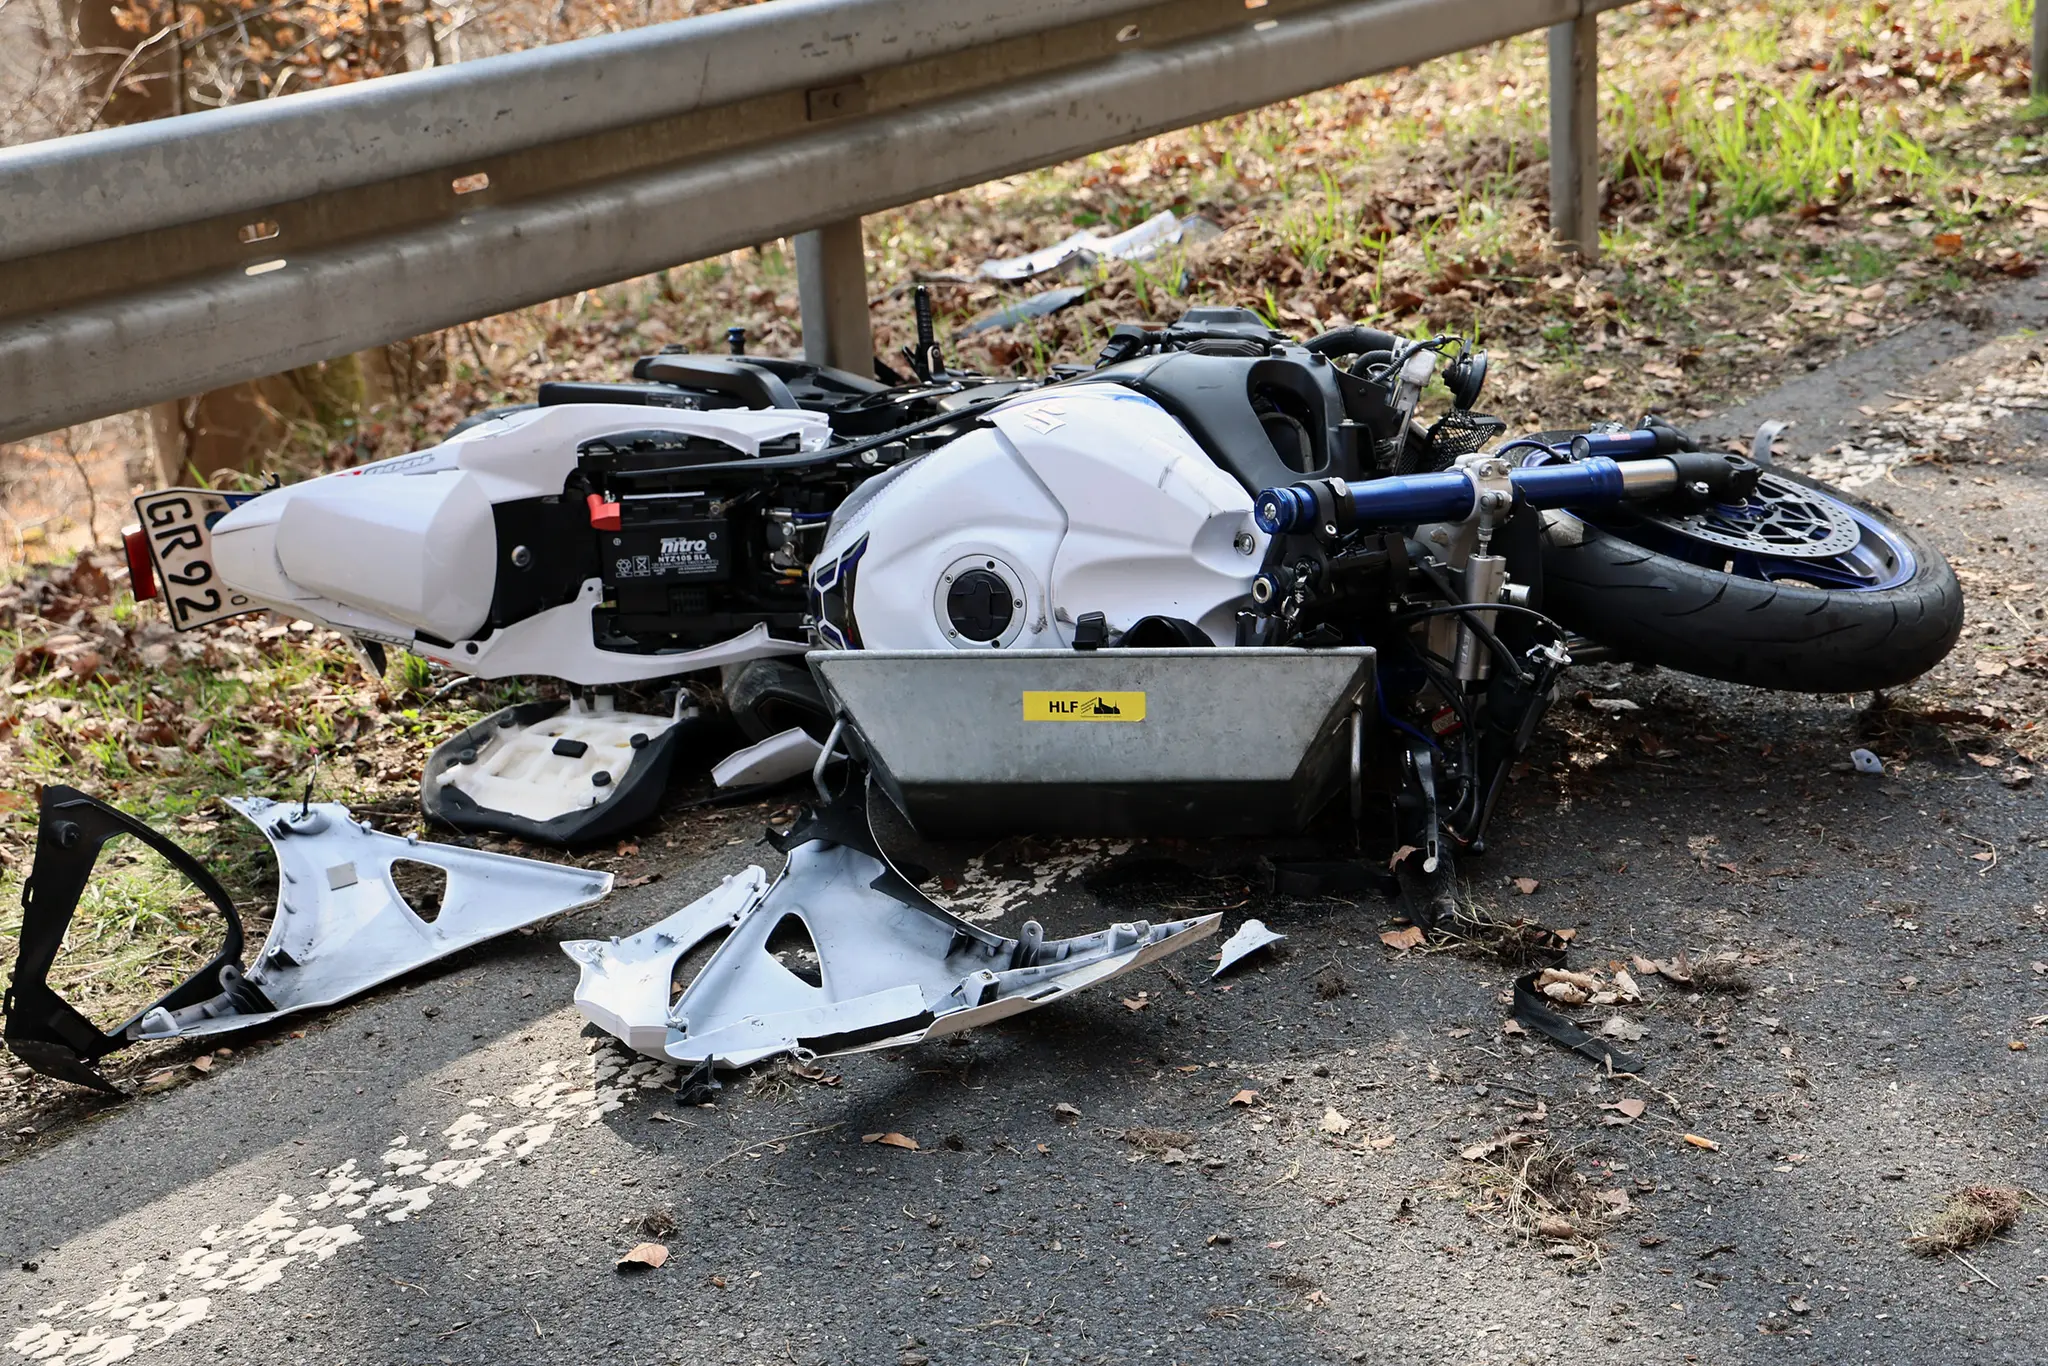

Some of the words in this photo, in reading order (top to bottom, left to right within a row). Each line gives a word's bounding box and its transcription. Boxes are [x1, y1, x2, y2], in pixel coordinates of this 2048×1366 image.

[660, 537, 707, 553] nitro
[658, 554, 692, 563] NTZ10S
[694, 553, 711, 561] SLA
[1049, 701, 1078, 713] HLF
